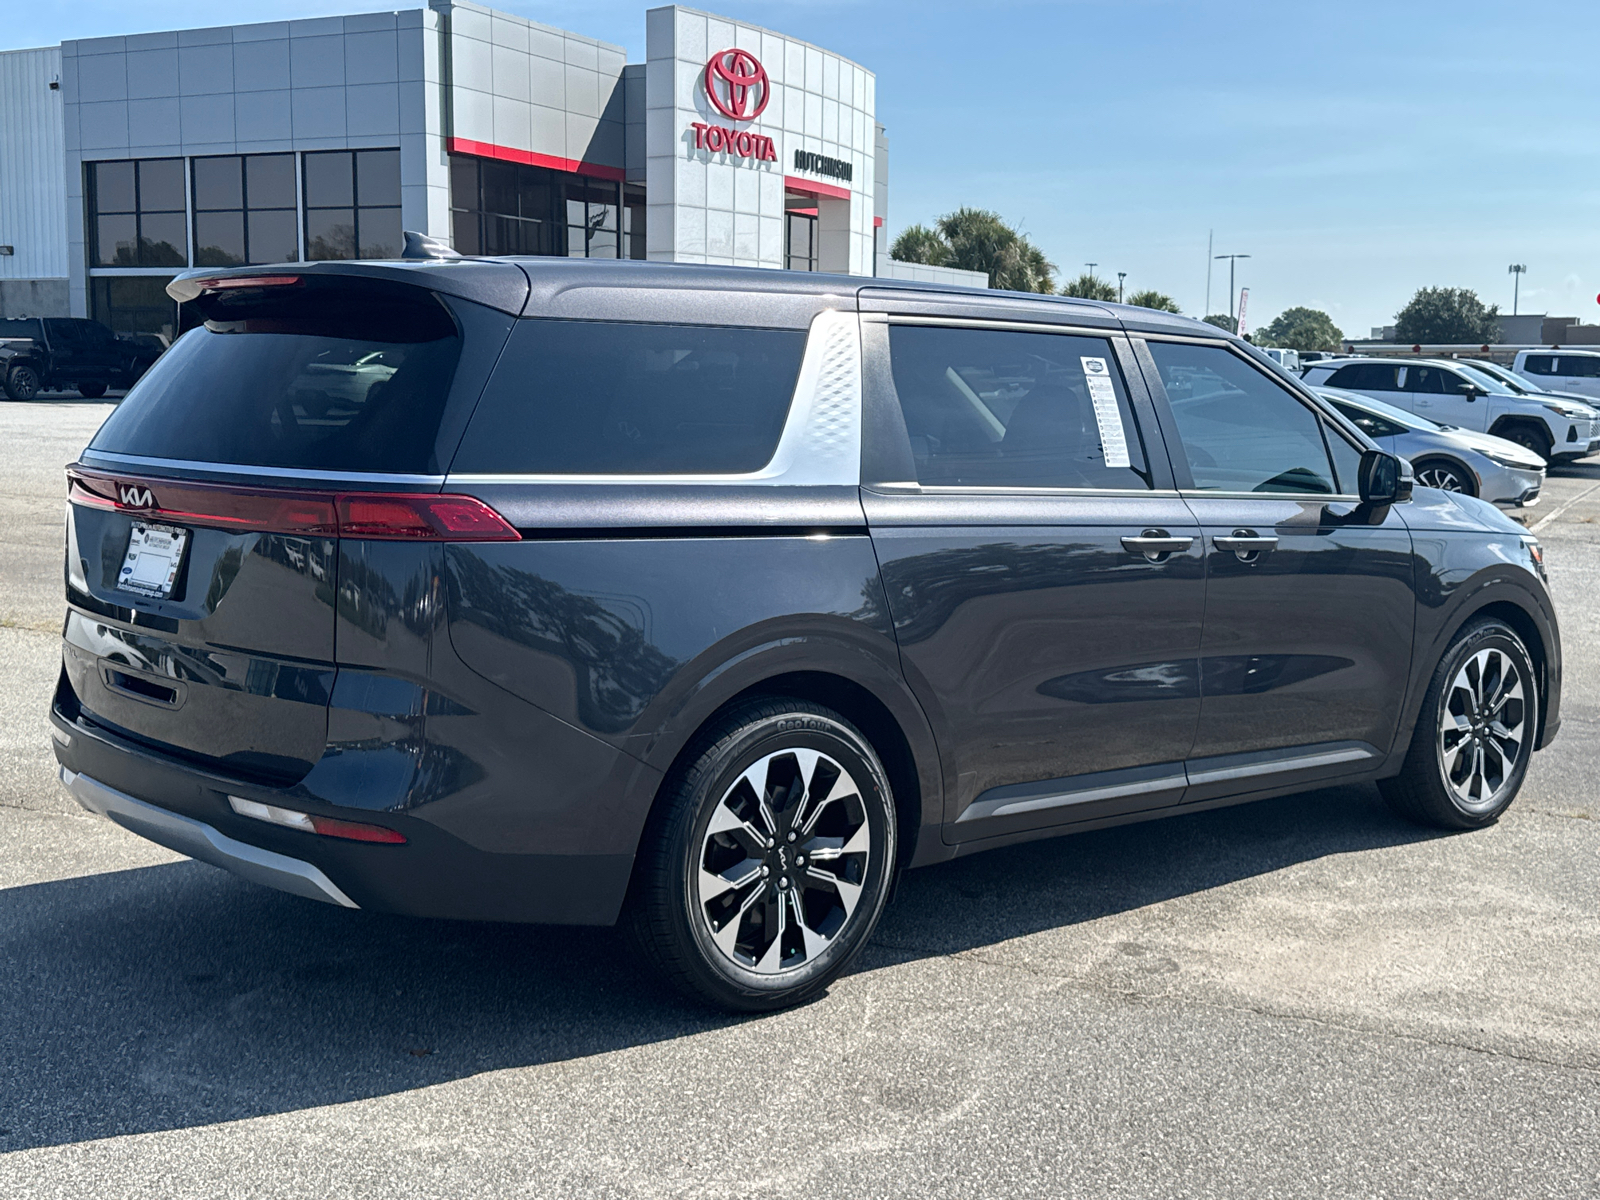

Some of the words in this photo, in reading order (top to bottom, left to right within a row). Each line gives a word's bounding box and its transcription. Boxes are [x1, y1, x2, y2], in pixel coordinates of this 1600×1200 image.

[691, 122, 778, 162] TOYOTA
[794, 149, 852, 181] HUTCHINSON
[120, 486, 153, 507] KIA
[776, 717, 832, 731] GeoTour
